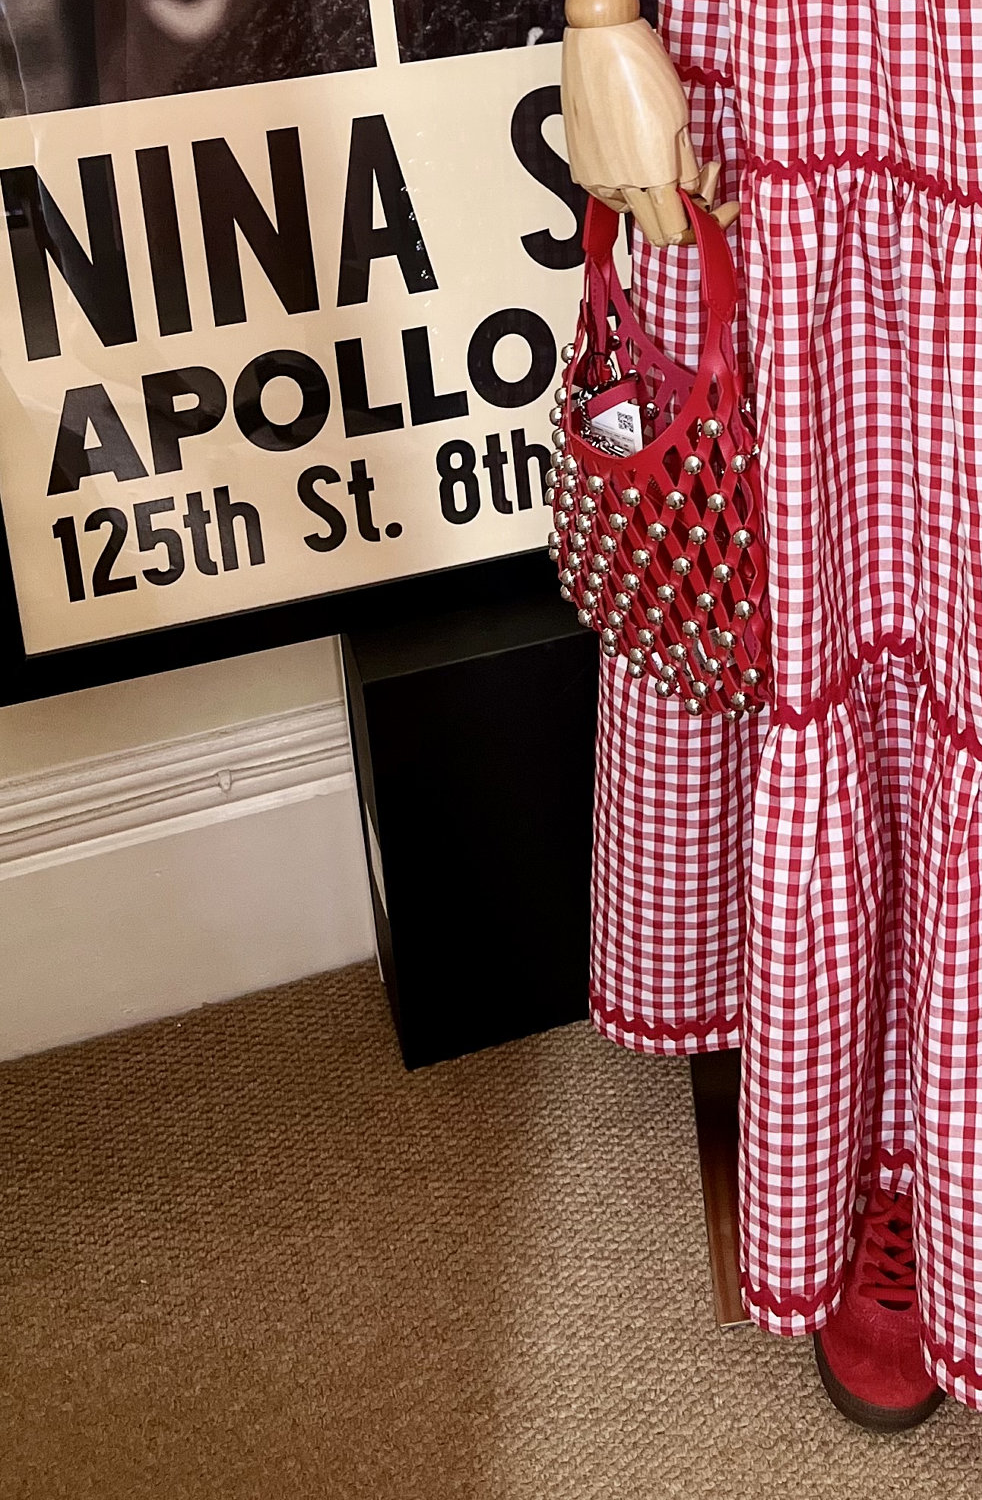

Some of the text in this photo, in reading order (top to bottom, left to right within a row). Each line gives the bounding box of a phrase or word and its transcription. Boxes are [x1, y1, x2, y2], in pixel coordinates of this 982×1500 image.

[0, 85, 590, 361] NINA S
[46, 308, 557, 497] APOLLO
[52, 428, 553, 603] 125th St. 8th
